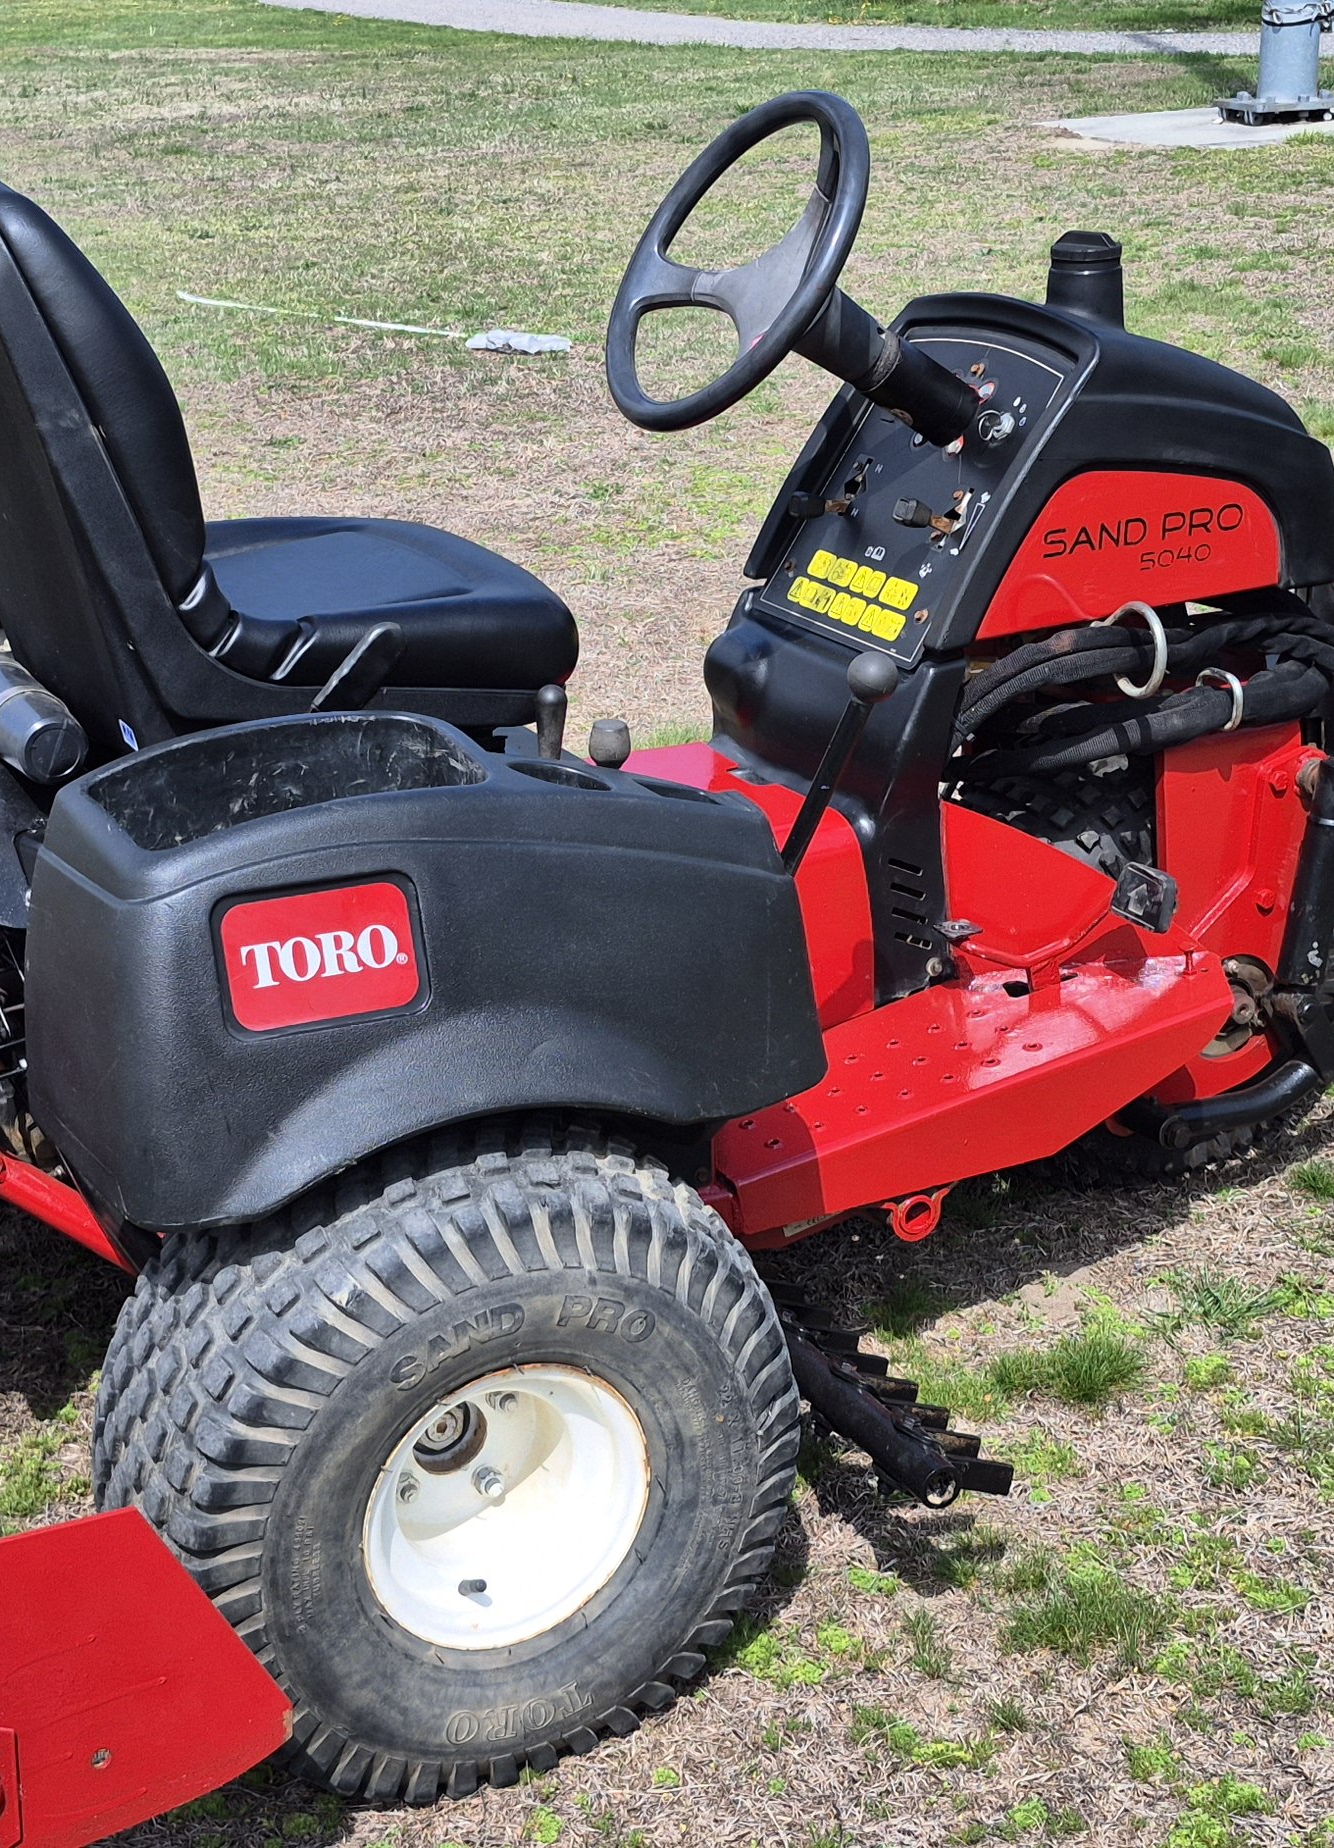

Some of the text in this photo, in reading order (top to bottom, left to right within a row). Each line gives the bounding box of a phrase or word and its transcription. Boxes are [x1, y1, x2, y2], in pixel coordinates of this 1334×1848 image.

[1043, 503, 1244, 559] SAND PRO
[1140, 543, 1211, 570] 5040
[240, 924, 398, 990] TORO
[389, 1294, 657, 1391] SAND PRO
[444, 1680, 595, 1746] TORO
